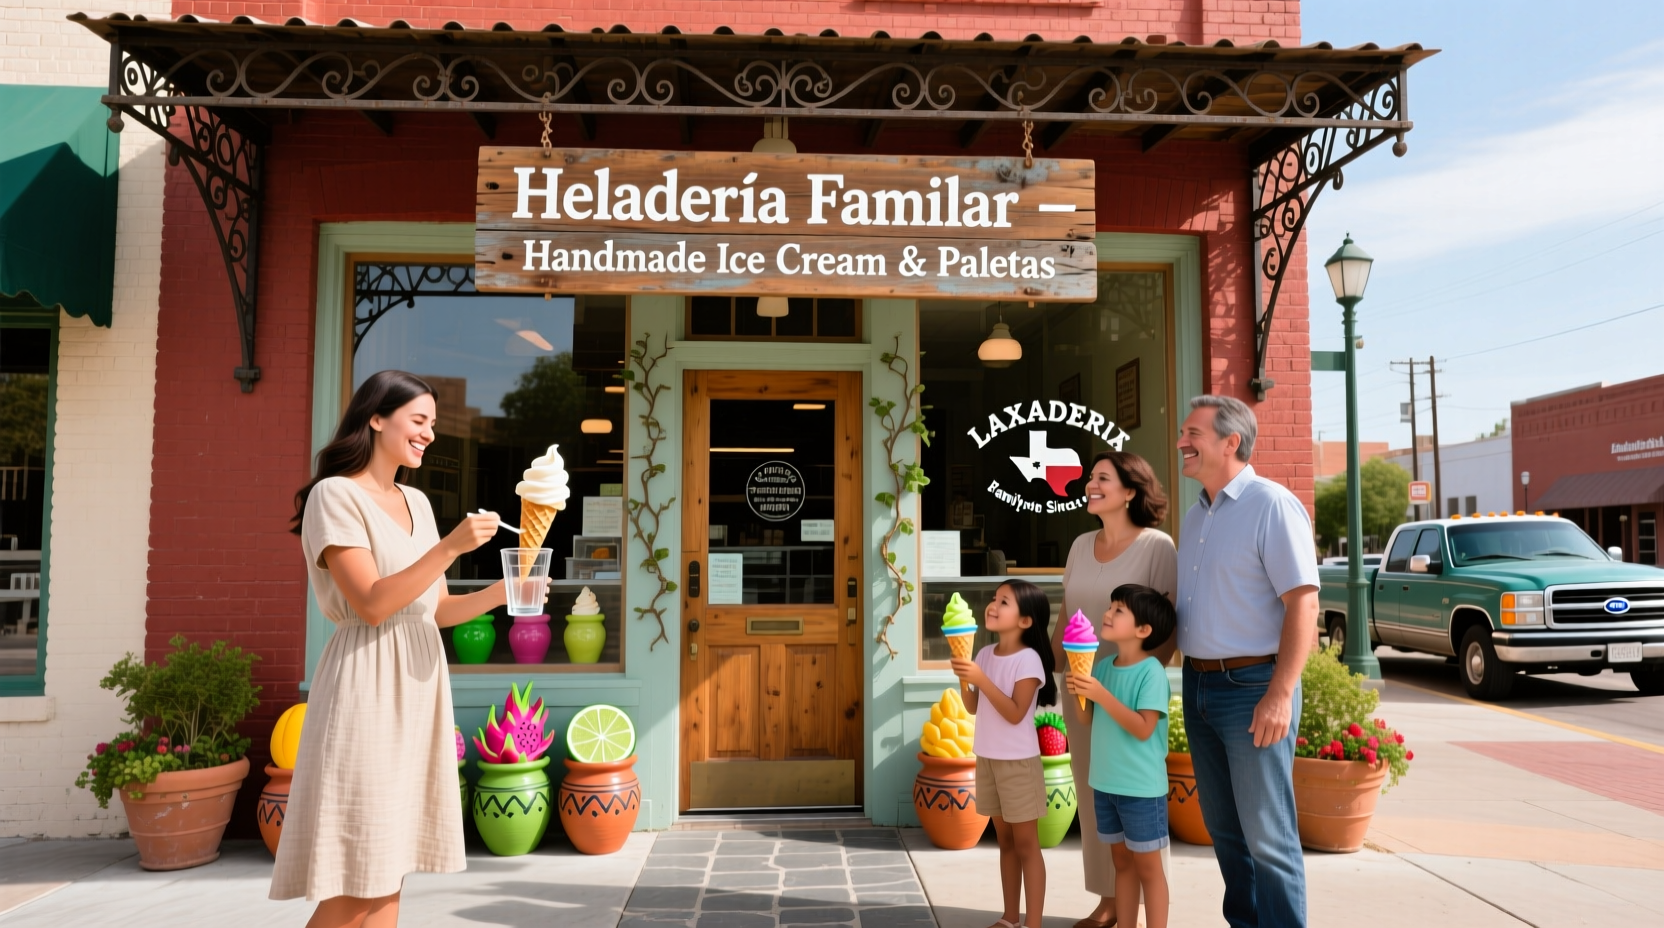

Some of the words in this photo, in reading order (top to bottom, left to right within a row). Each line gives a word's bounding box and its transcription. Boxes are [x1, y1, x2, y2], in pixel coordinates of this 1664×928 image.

[512, 166, 789, 224] Heladería
[807, 173, 1019, 228] Familar
[522, 239, 706, 273] Handmade
[717, 243, 765, 275] Ice
[776, 243, 887, 276] Cream
[898, 245, 926, 277] &
[936, 246, 1056, 279] Paletas
[967, 400, 1131, 452] LAXADERIA
